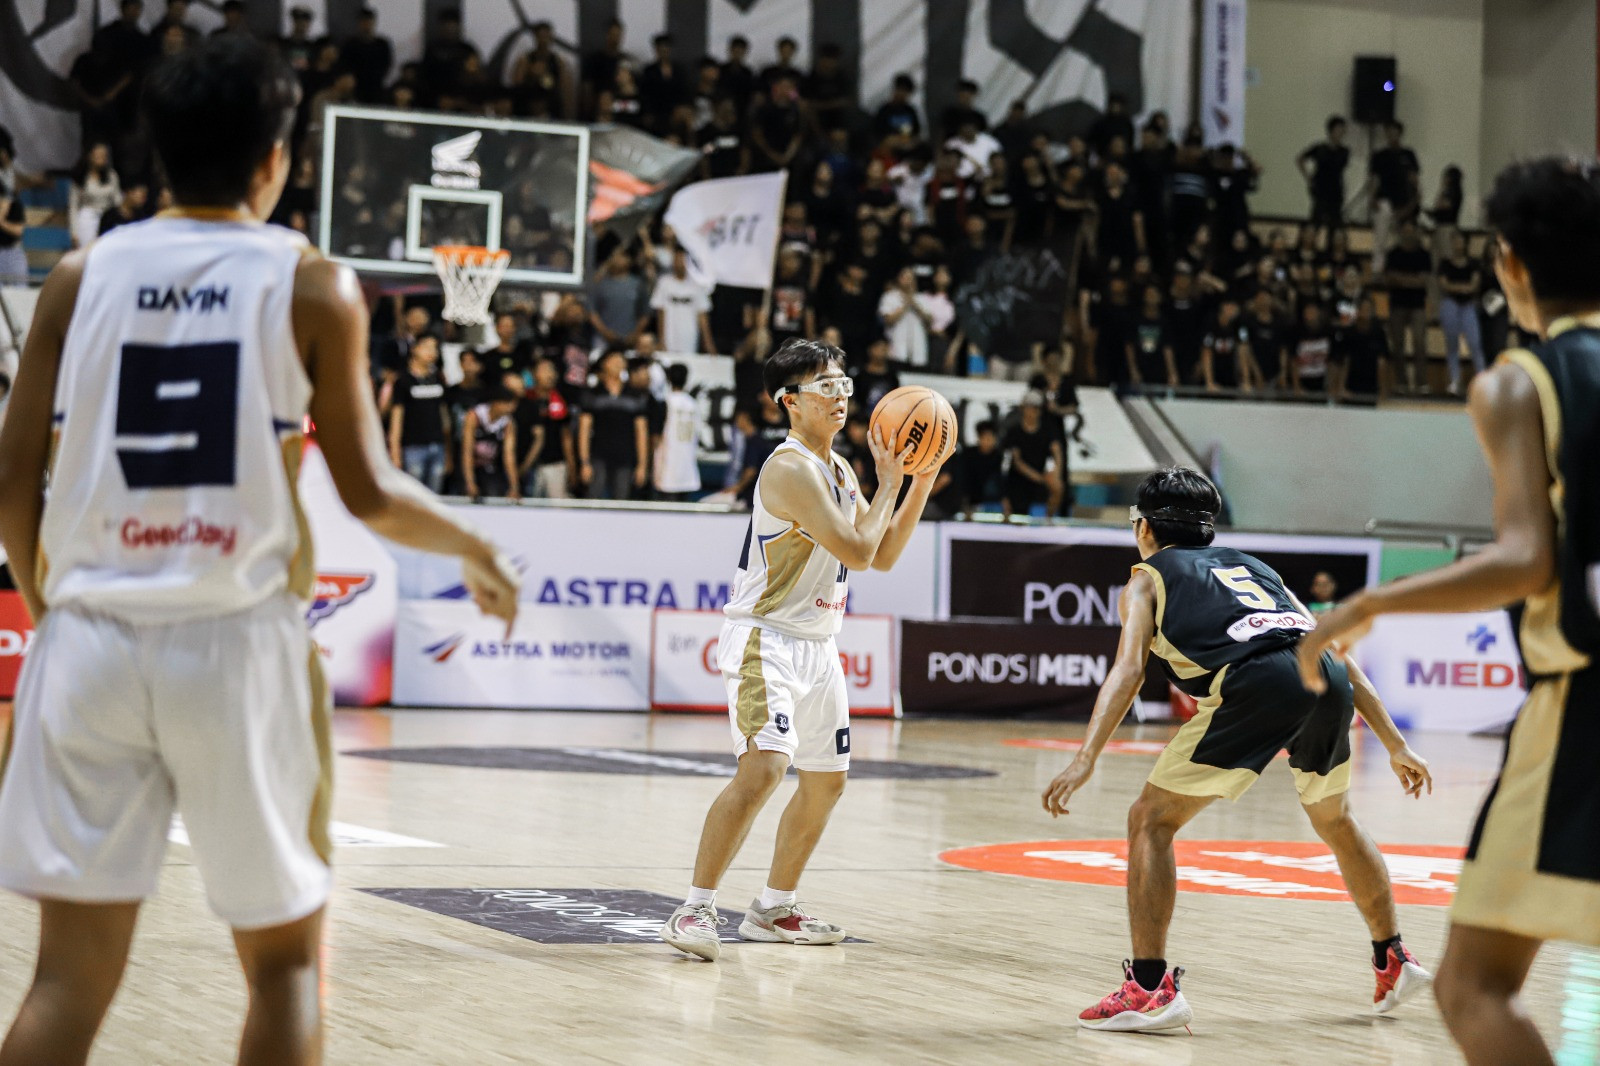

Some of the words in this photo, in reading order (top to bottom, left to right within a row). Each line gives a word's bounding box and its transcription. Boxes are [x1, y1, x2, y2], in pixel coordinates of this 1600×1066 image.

[138, 284, 229, 312] DAVIN
[115, 341, 239, 489] 9
[537, 578, 678, 611] ASTRA
[1024, 582, 1121, 625] PON
[1210, 565, 1276, 610] 5
[471, 641, 543, 658] ASTRA
[551, 643, 631, 659] MOTOR
[928, 652, 1029, 683] POND'S
[1037, 654, 1107, 686] MEN
